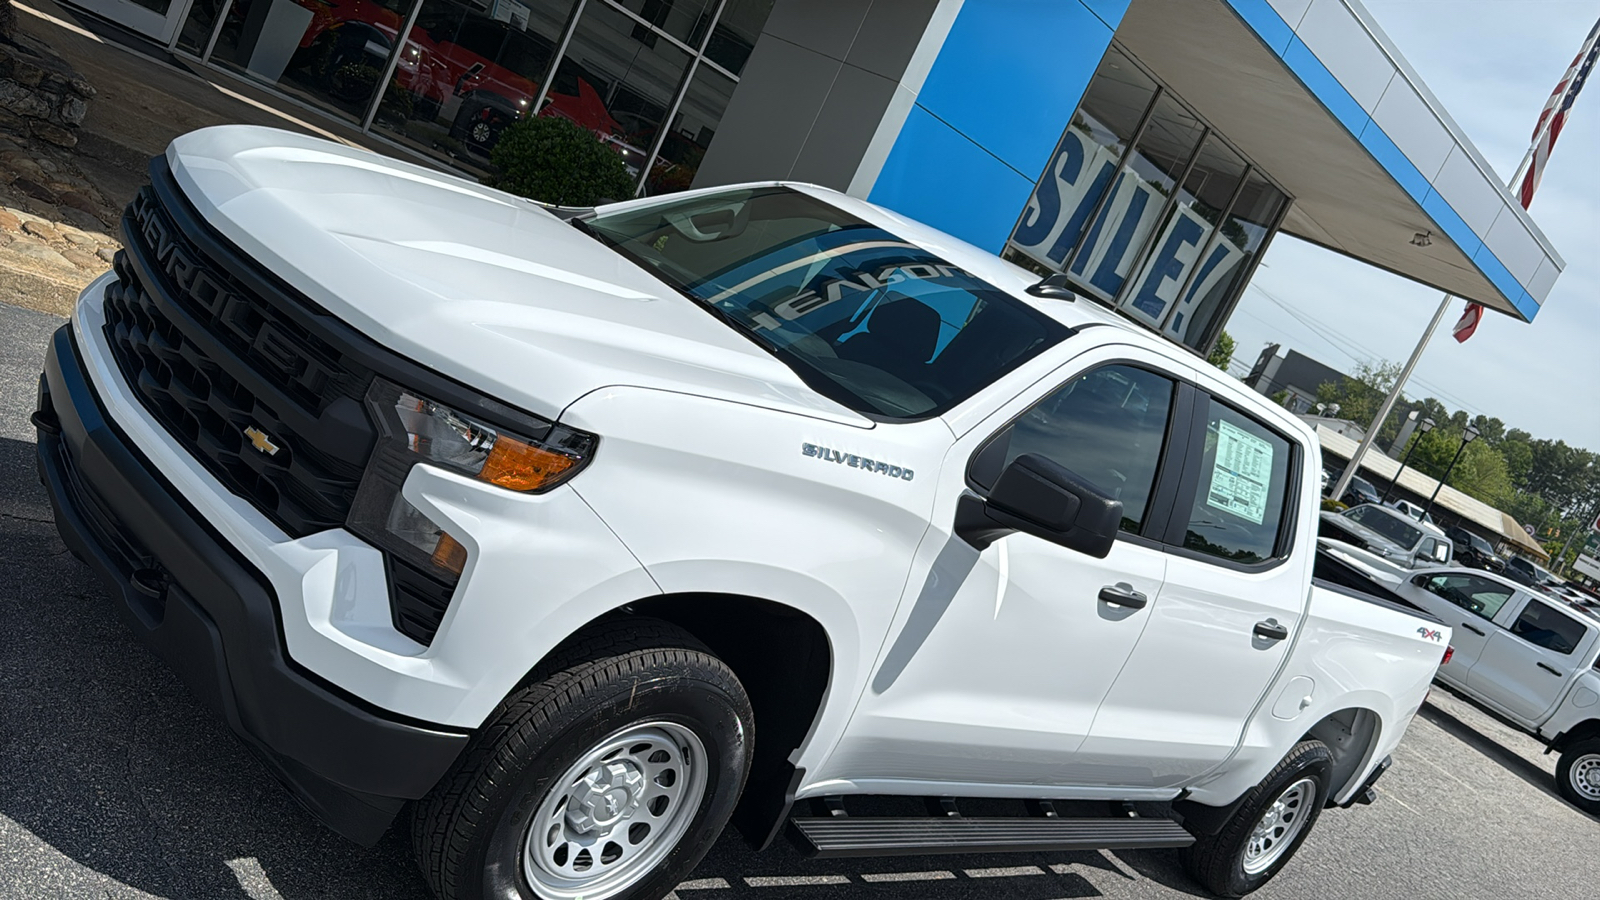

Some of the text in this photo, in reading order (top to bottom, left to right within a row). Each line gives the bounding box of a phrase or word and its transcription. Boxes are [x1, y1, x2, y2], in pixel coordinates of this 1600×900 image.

[132, 188, 346, 398] CHEVROLET
[1012, 130, 1230, 334] SALE!
[801, 442, 914, 481] SILVERADO
